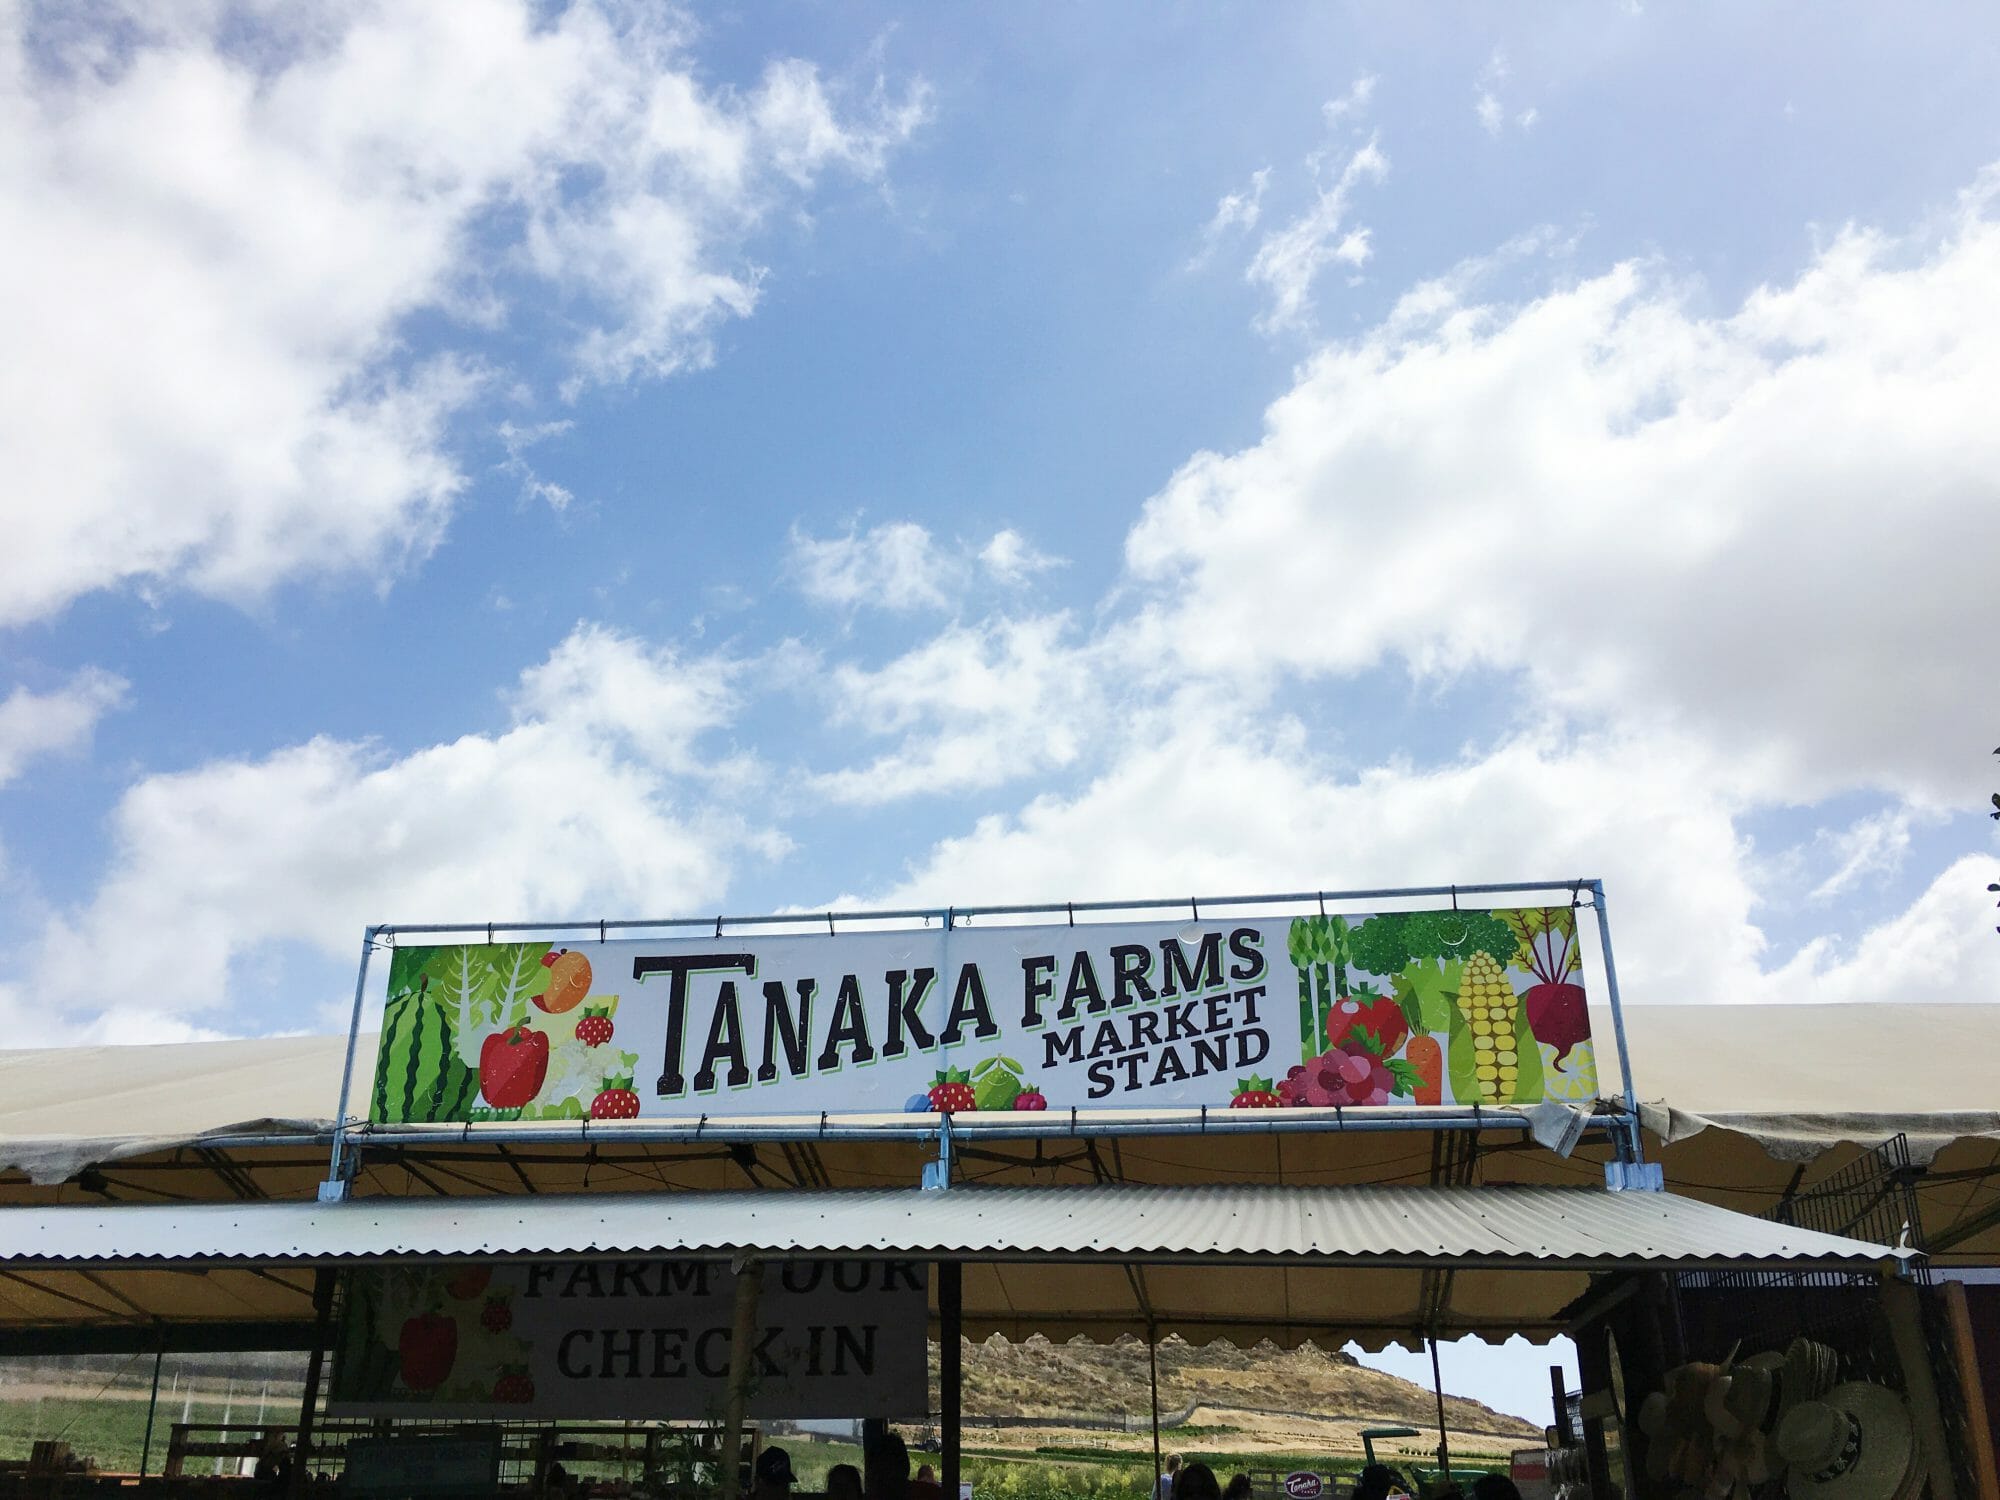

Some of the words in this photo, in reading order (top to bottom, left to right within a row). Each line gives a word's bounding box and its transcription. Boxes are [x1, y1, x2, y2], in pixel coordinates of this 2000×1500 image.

[632, 952, 998, 1097] TANAKA
[1021, 927, 1266, 1029] FARMS
[1041, 985, 1267, 1068] MARKET
[1086, 1027, 1271, 1098] STAND
[523, 1261, 711, 1297] FARM
[764, 1260, 924, 1296] OUR
[557, 1327, 789, 1379] CHECK
[804, 1325, 880, 1378] IN
